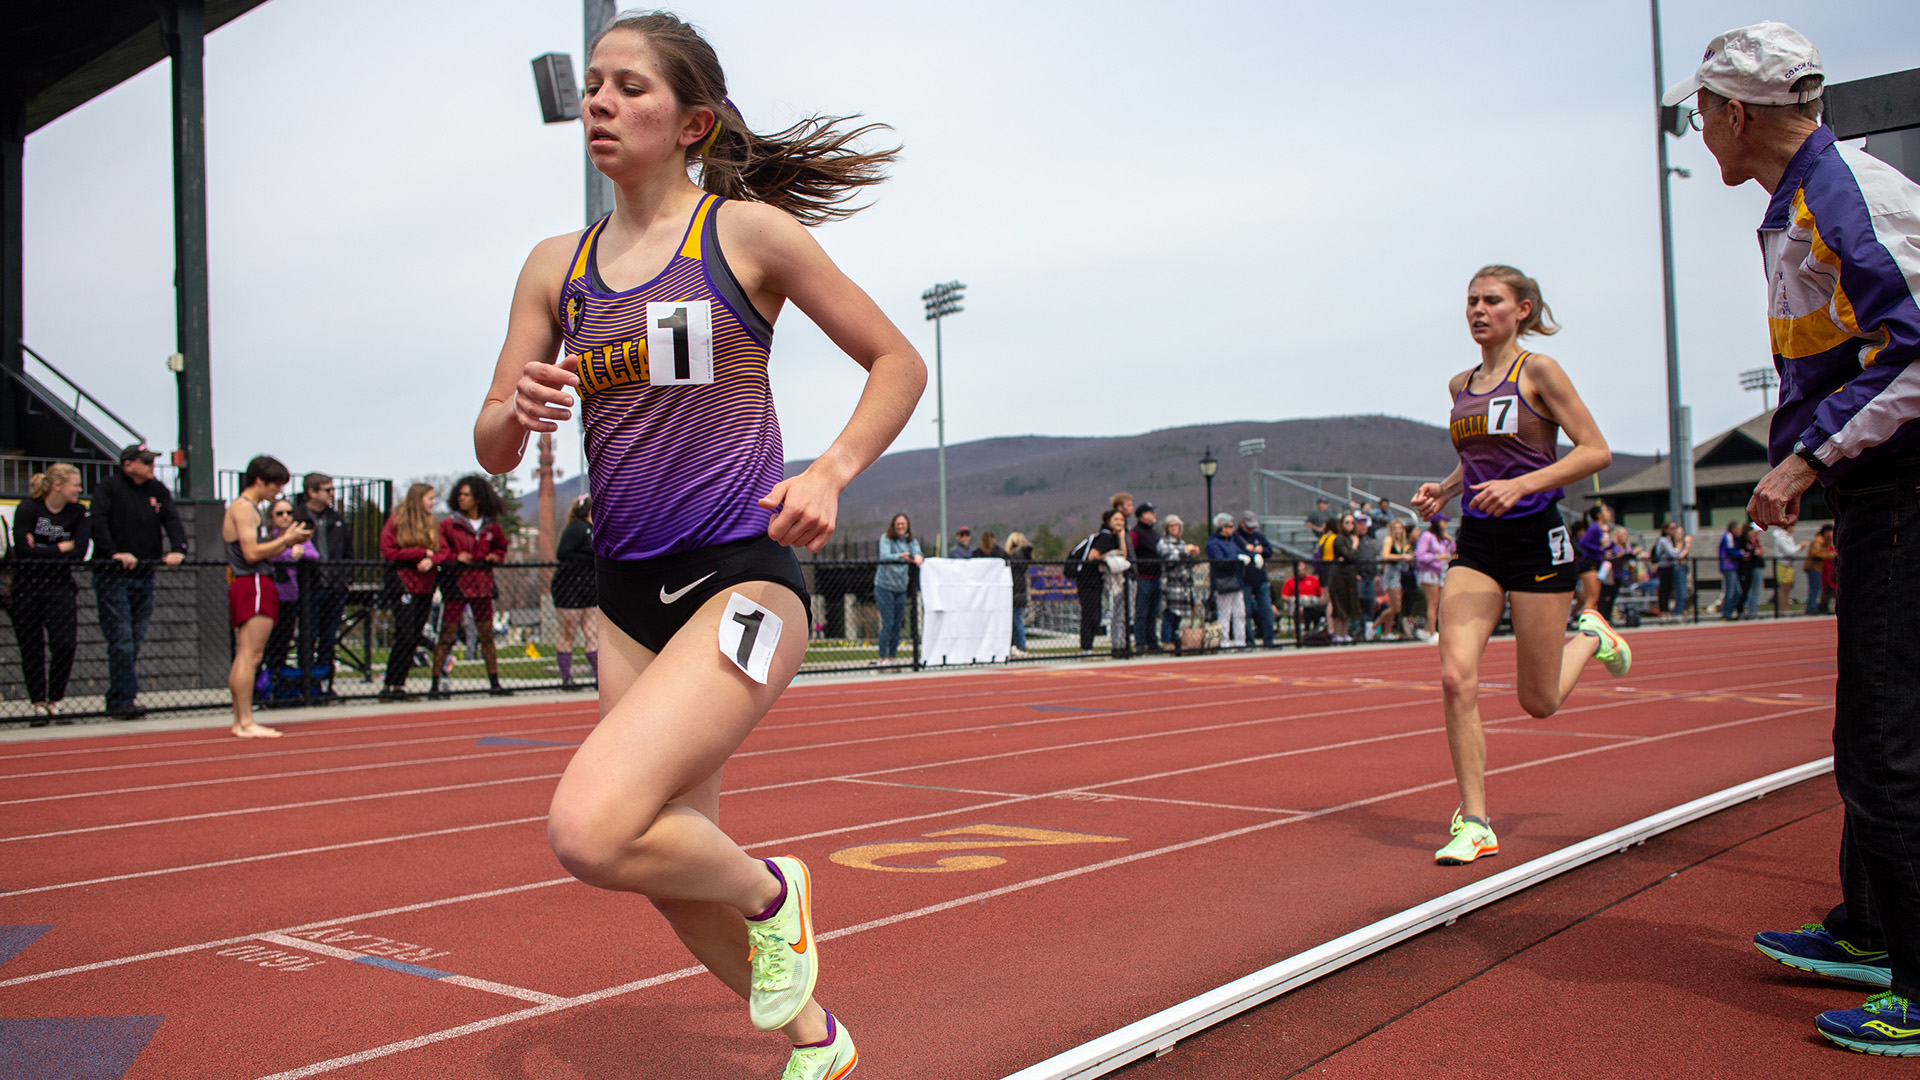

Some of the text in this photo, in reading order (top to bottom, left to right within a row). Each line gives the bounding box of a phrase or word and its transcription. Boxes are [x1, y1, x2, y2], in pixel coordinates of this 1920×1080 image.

[1784, 63, 1806, 79] COACH
[658, 307, 691, 380] 1
[576, 338, 650, 401] ILLIA
[1493, 399, 1513, 431] 7
[1551, 530, 1566, 560] 7
[732, 609, 765, 671] 1
[829, 822, 1130, 873] 2
[216, 945, 326, 972] 1600
[288, 928, 450, 962] RELAY
